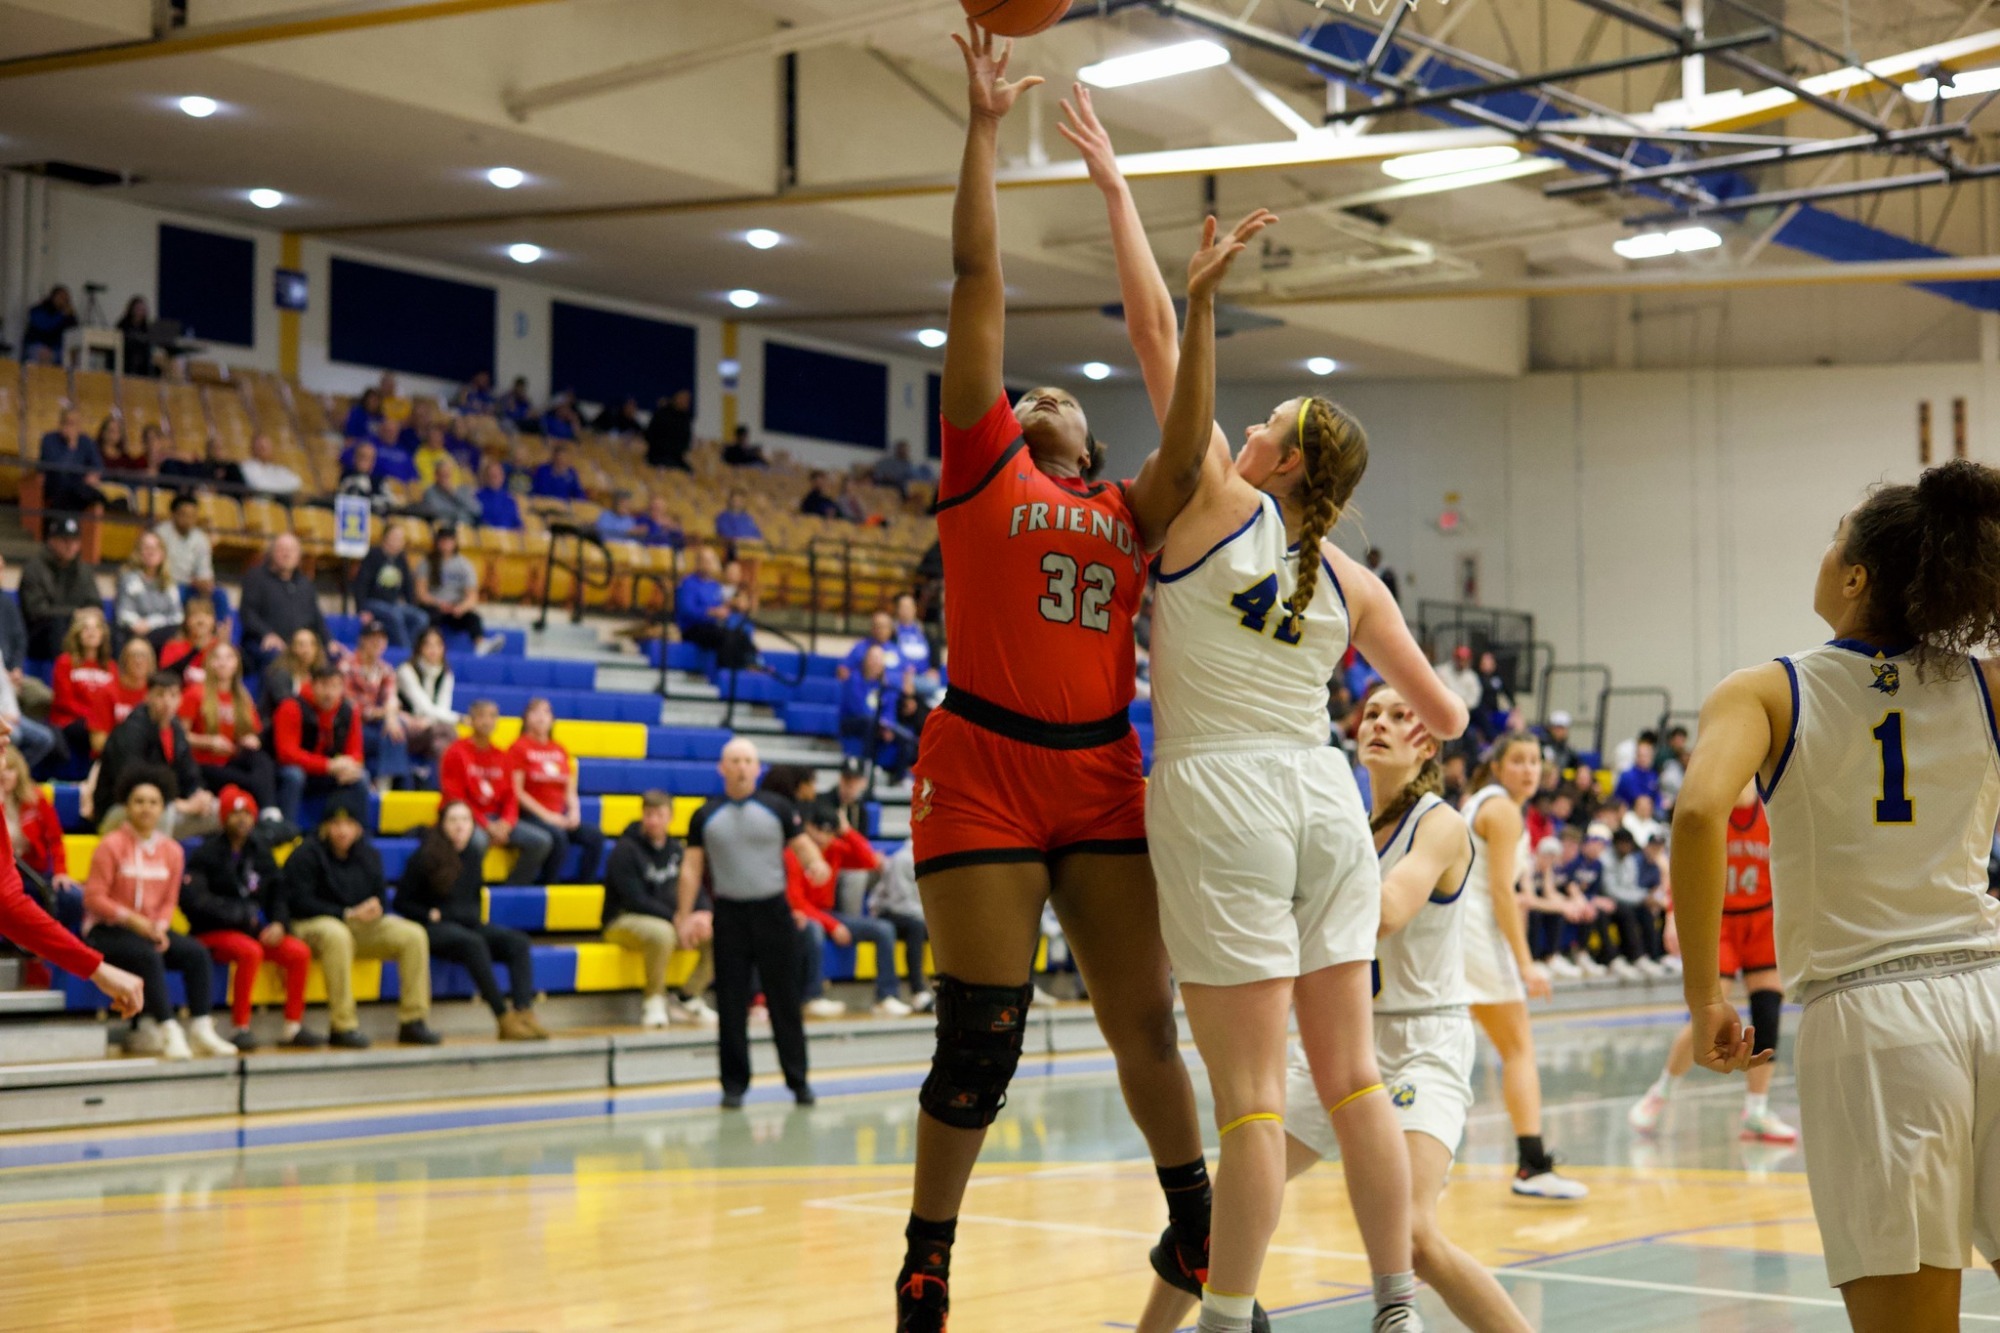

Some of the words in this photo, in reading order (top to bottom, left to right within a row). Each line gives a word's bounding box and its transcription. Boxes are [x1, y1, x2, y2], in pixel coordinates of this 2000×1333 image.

[1038, 551, 1116, 634] 32
[1870, 708, 1916, 826] 1
[1727, 864, 1759, 895] 14
